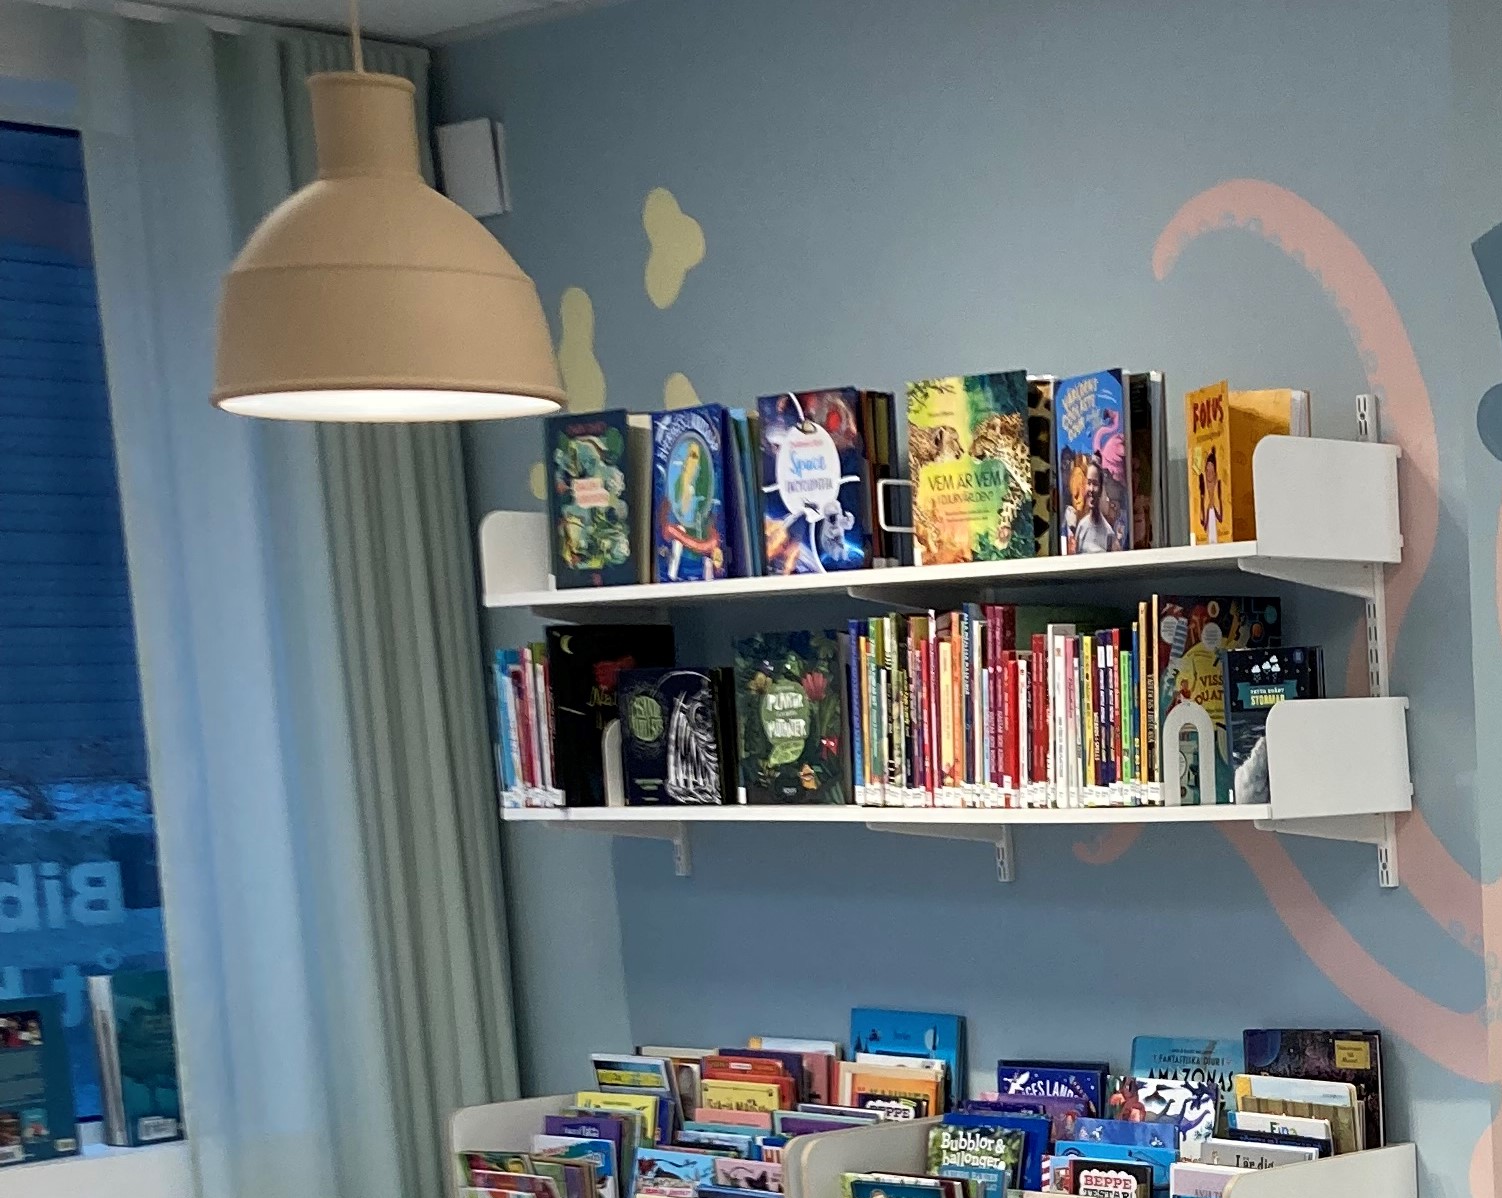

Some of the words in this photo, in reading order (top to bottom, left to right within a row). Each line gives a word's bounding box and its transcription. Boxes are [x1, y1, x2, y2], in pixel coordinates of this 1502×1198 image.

[928, 474, 955, 491] VEM
[974, 469, 1002, 488] VEM
[1148, 1067, 1234, 1092] AMAZONAS
[941, 1131, 994, 1152] Bubblor
[994, 1138, 1006, 1154] &
[1084, 1174, 1132, 1190] BEPPE
